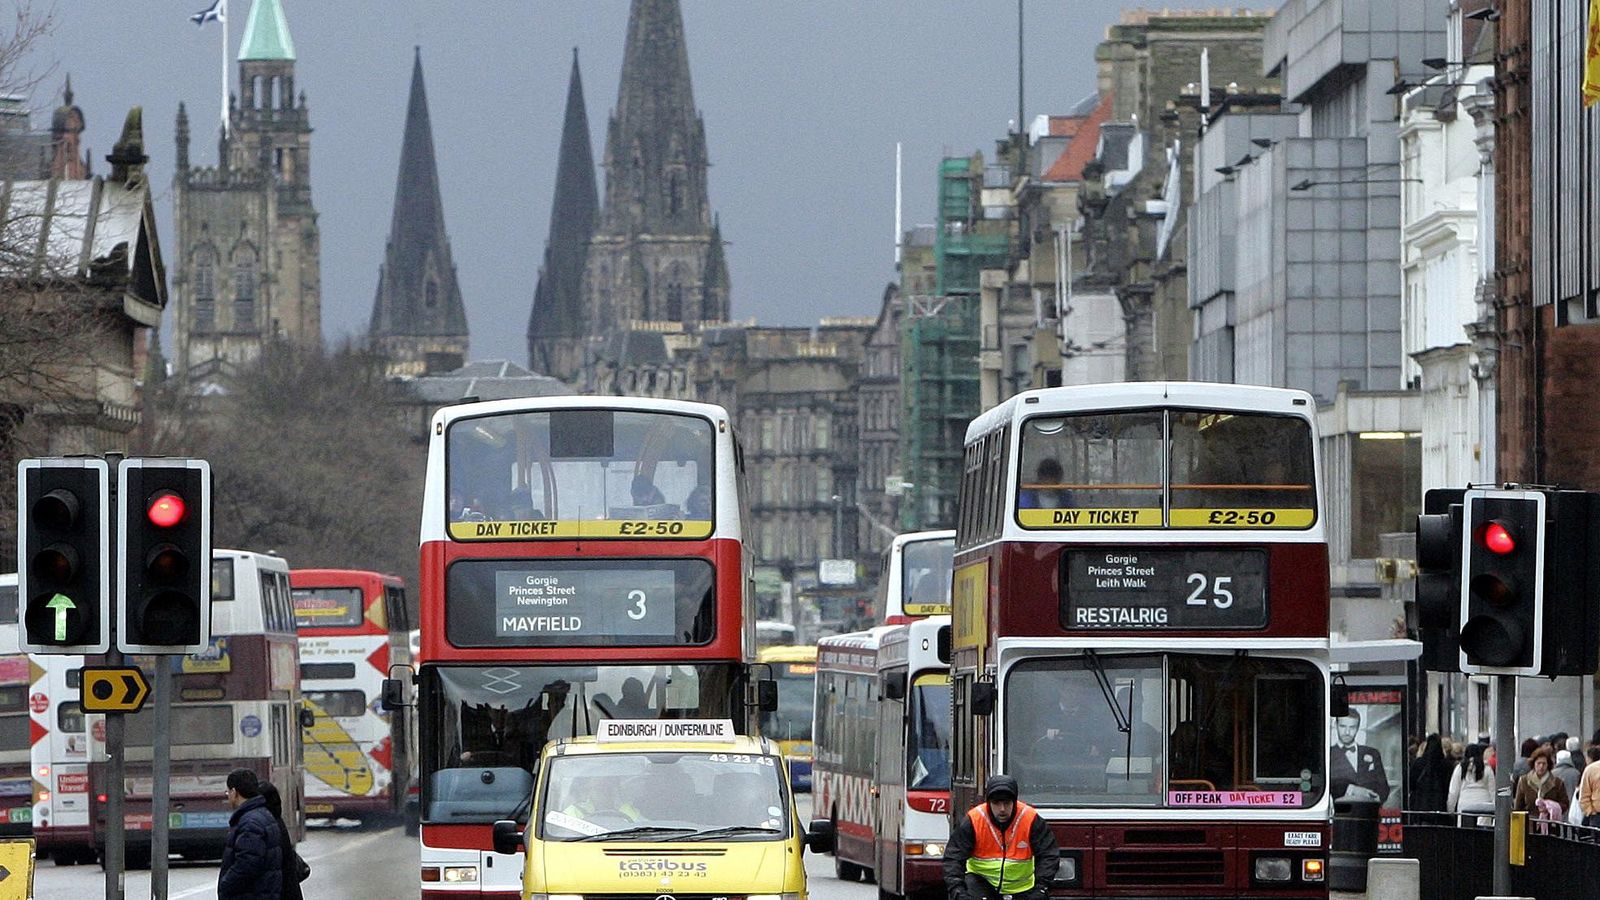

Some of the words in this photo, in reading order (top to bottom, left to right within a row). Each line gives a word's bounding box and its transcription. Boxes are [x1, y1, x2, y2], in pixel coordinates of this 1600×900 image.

[1053, 511, 1079, 524] DAY
[1089, 510, 1139, 524] TICKET
[476, 523, 502, 536] DAY
[509, 522, 558, 536] TICKET
[1105, 554, 1138, 565] Gorgie
[1088, 566, 1123, 576] Princes
[1125, 566, 1155, 576] Street
[526, 576, 558, 586] Gorgie
[1096, 578, 1120, 588] Leith
[1122, 578, 1147, 588] Walk
[509, 586, 543, 596] Princes
[546, 586, 576, 596] Street
[1186, 573, 1234, 609] 25
[517, 596, 568, 606] Newington
[627, 590, 647, 620] 3
[920, 605, 935, 613] DAY
[940, 605, 952, 613] TIC
[1076, 607, 1168, 623] RESTALRIG
[503, 617, 582, 631] MAYFIELD
[608, 723, 657, 737] EDINBURGH
[658, 723, 664, 737] /
[664, 723, 724, 736] DUNFERMLINE
[709, 754, 728, 763] 43
[733, 755, 751, 764] 23
[756, 756, 774, 766] 43
[1175, 794, 1193, 803] OFF
[1196, 794, 1222, 803] PEAK
[1230, 793, 1246, 801] DAY
[1247, 794, 1275, 804] TICKET
[1283, 794, 1295, 804] £2
[929, 799, 945, 811] 72
[619, 859, 707, 870] taxibus
